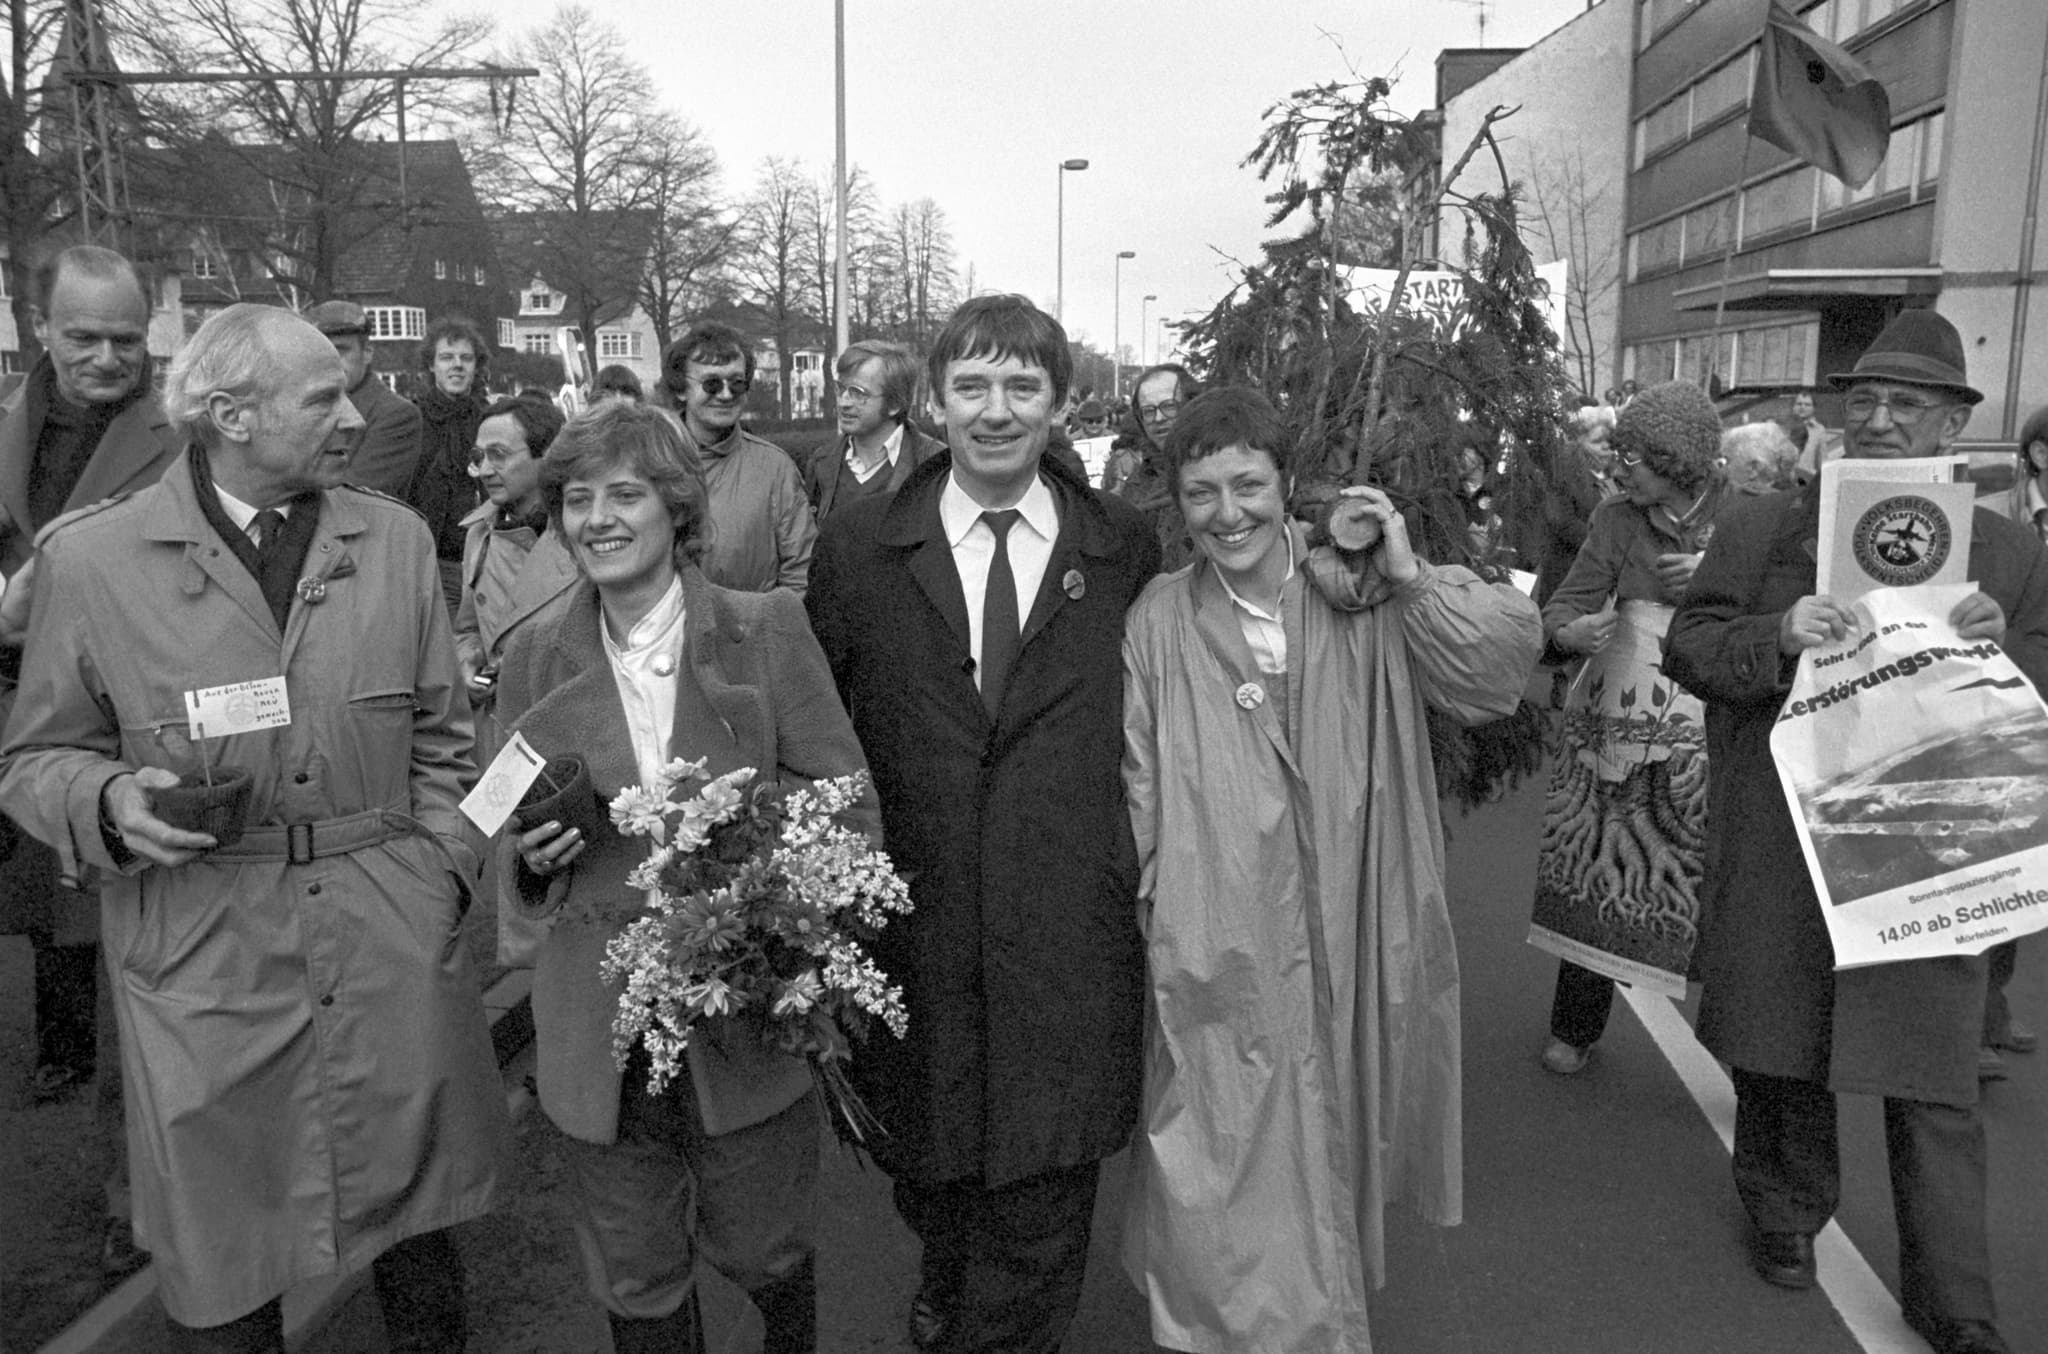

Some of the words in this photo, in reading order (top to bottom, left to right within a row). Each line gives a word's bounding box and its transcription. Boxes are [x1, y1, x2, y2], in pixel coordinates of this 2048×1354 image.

[1862, 497, 1949, 550] VOLKSBEGEHREN
[1869, 520, 1887, 545] Keine
[1887, 511, 1933, 531] Startbahn
[1854, 534, 1943, 586] VOLKSENTSCHEID
[1813, 652, 1844, 669] Seht
[1880, 622, 1902, 636] an
[1908, 866, 2022, 905] Sonntagsspaziergänge
[1876, 920, 1922, 944] 14.00
[1927, 914, 1952, 932] ab
[1954, 925, 2009, 945] Mörfelden
